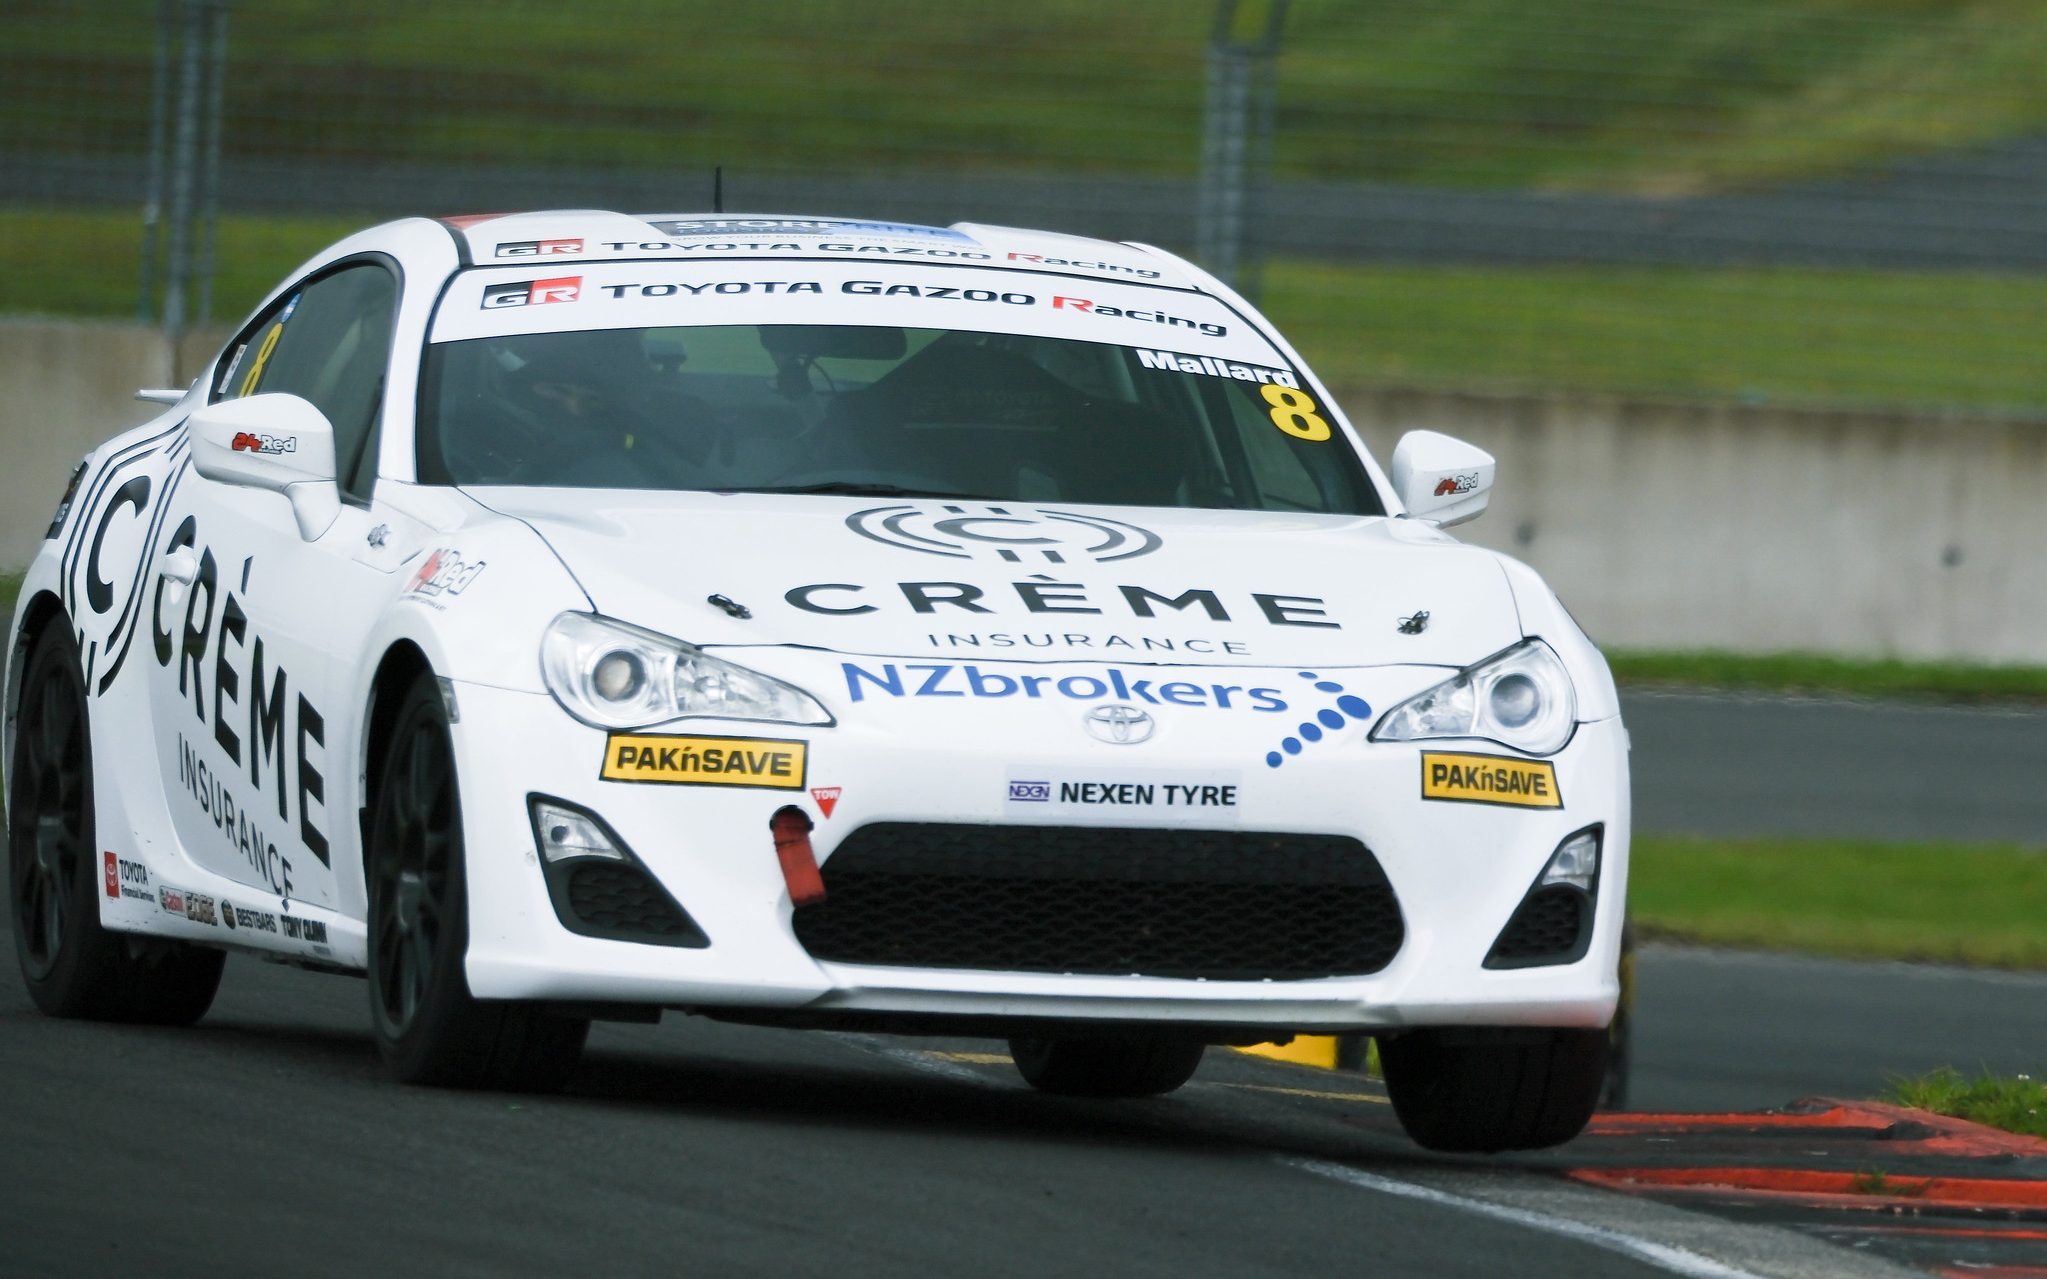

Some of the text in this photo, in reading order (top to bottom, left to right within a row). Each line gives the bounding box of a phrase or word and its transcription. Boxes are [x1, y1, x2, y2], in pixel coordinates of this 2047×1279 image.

[497, 240, 583, 257] GR
[601, 242, 803, 251] TOYOTA
[818, 243, 992, 260] GAZOO
[1007, 252, 1160, 279] Racing
[482, 280, 1227, 337] GR TOYOTA GAZOO Racing
[1136, 349, 1300, 389] Mallard
[1260, 383, 1332, 441] 8
[784, 574, 1342, 630] CRÈME
[928, 633, 1252, 656] INSURANCE
[841, 662, 1289, 713] NZbrokers
[813, 790, 840, 801] TOW
[1060, 782, 1238, 807] NEXEN TYRE
[179, 732, 295, 900] INSURANCE
[119, 859, 149, 886] TOYOTA
[236, 907, 278, 934] BESTBARS
